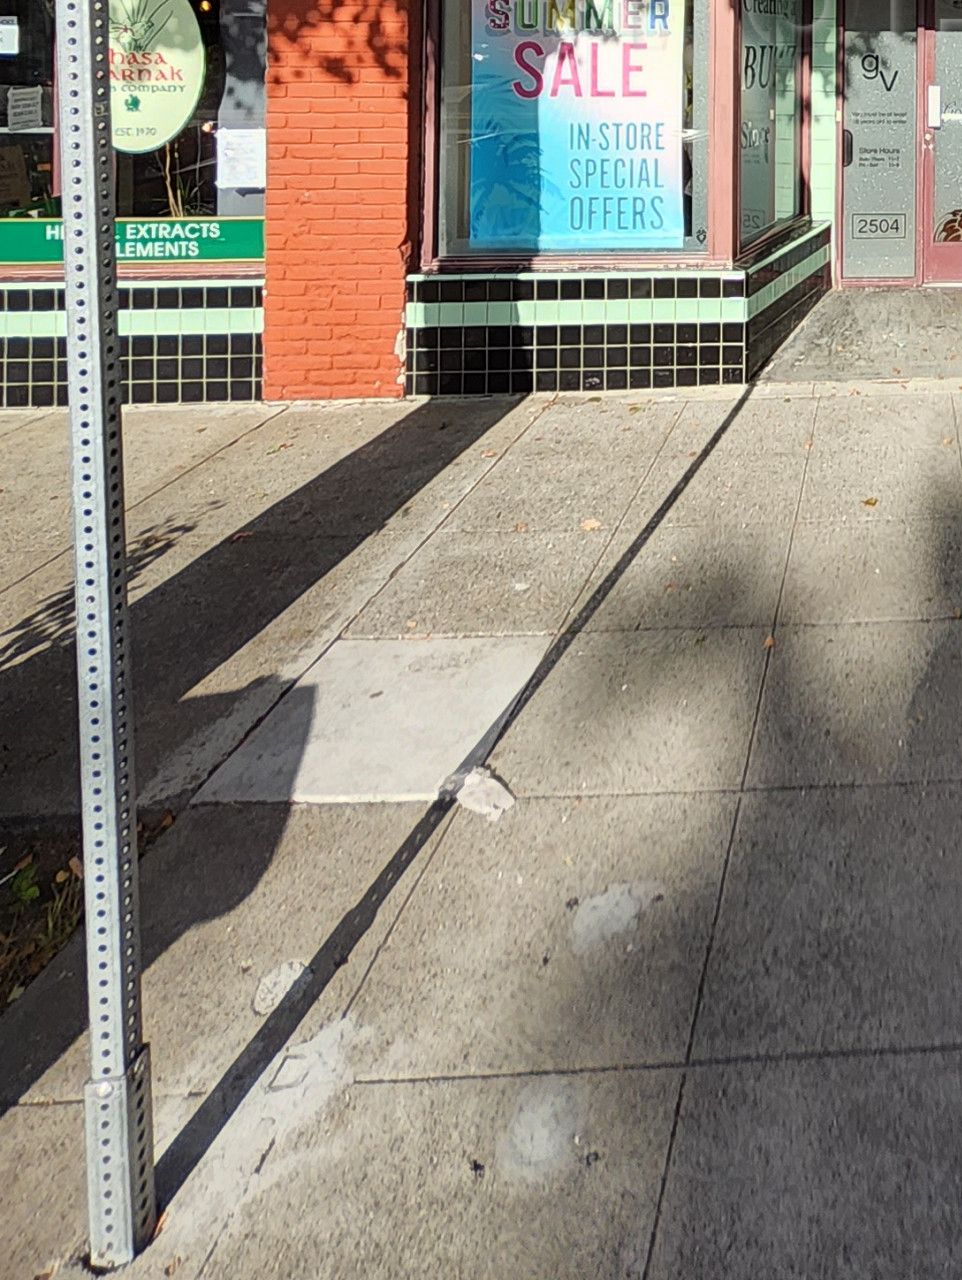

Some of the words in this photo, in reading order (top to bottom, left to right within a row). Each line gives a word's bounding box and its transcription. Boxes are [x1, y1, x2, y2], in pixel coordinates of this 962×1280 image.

[512, 40, 648, 100] SALE
[569, 122, 666, 151] IN-STORE
[569, 158, 665, 190] SPECIAL
[569, 195, 665, 231] OFFERS
[857, 218, 900, 234] 2504
[125, 222, 221, 240] EXTRACTS
